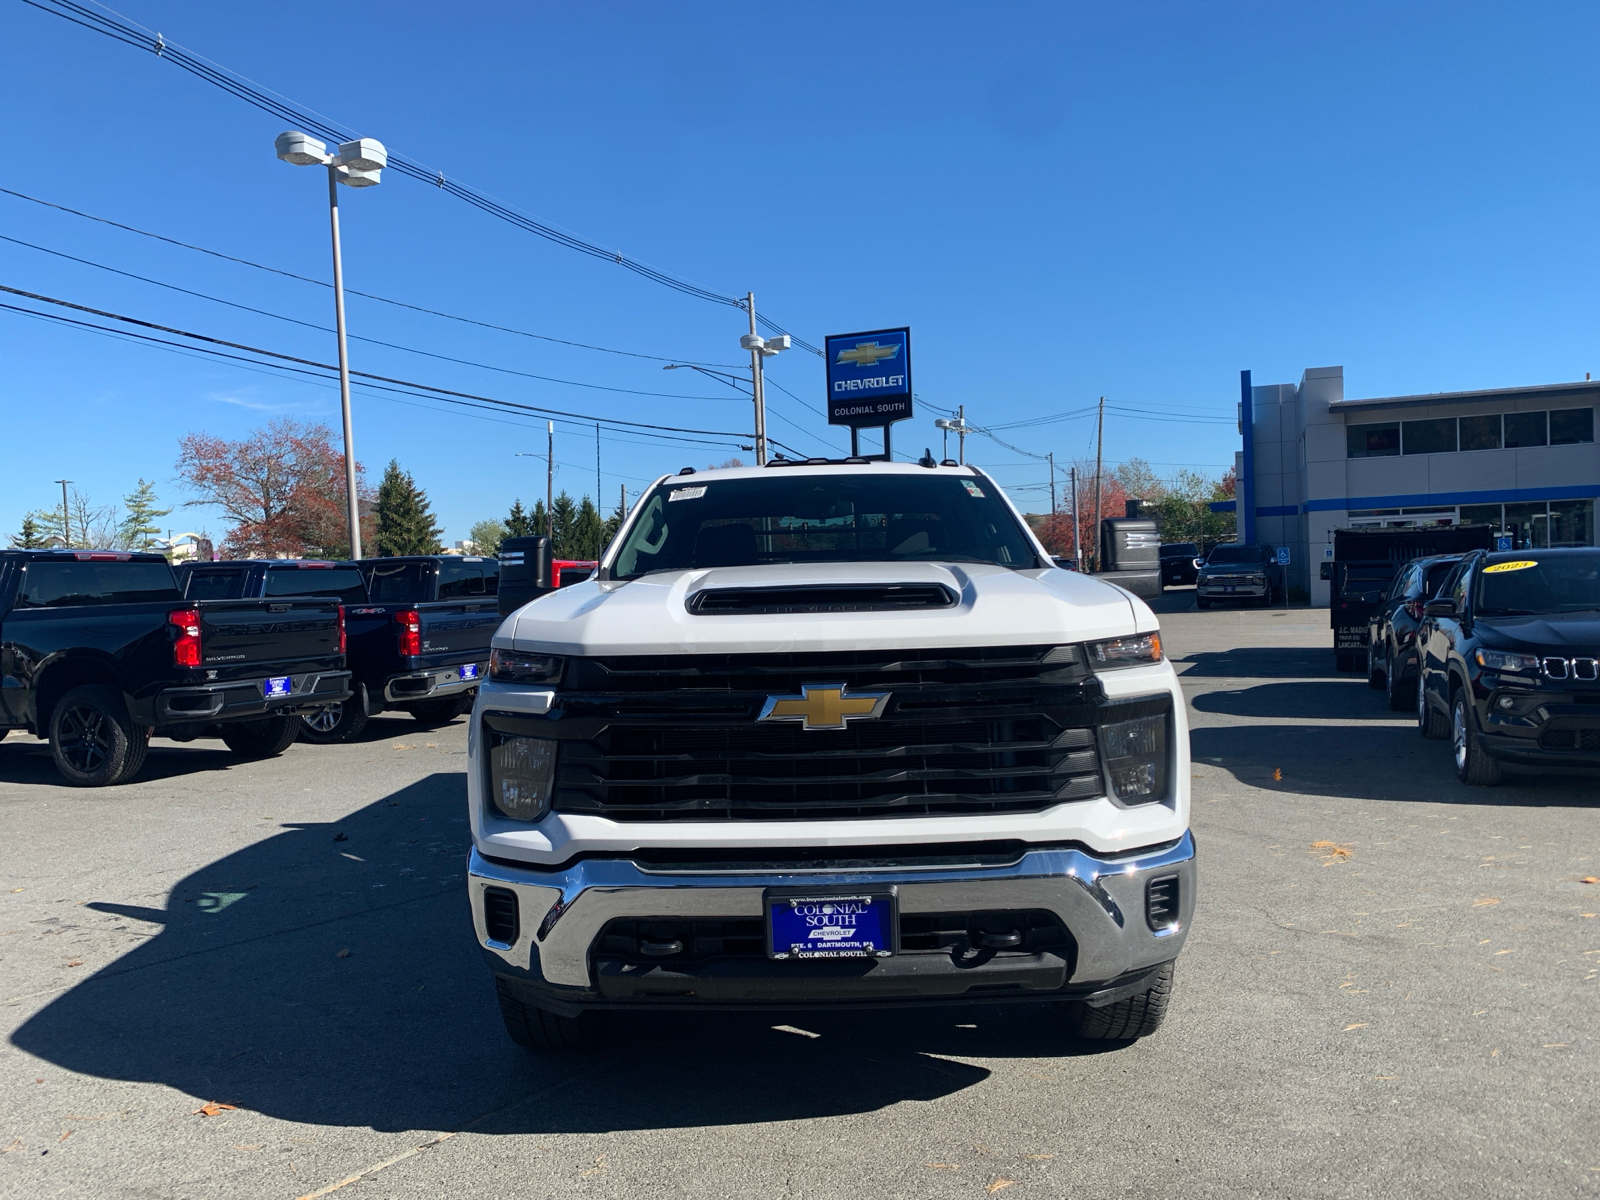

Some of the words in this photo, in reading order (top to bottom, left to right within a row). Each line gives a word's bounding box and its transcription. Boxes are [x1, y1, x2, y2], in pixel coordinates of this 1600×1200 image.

[834, 375, 904, 392] CHEVROLET
[834, 407, 875, 416] COLONIAL
[877, 403, 905, 412] SOUTH
[1493, 562, 1529, 572] 2023
[794, 903, 868, 916] COLONIAL
[806, 914, 857, 927] SOUTH
[817, 941, 862, 949] DARTMOUTH,
[798, 951, 839, 959] COLONIAL
